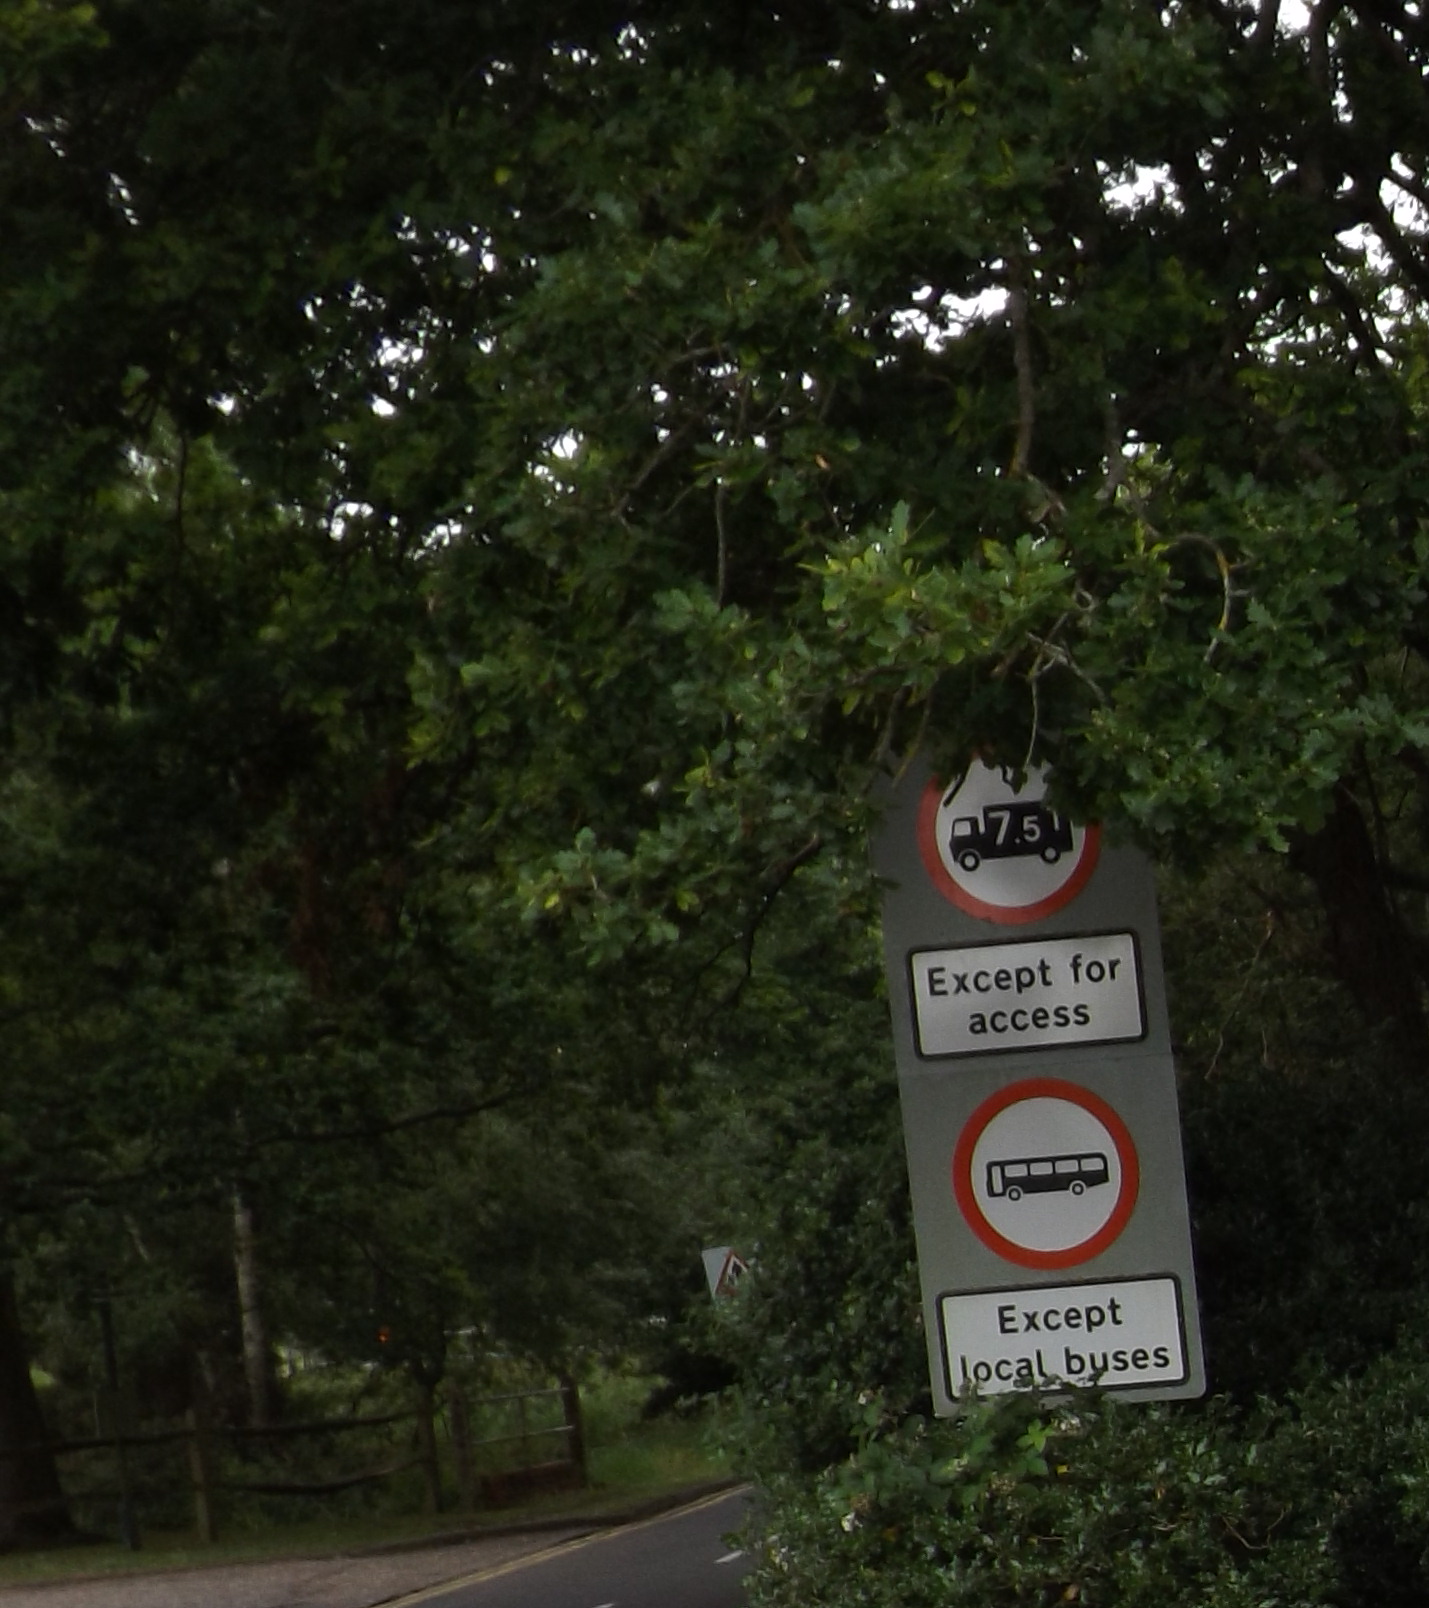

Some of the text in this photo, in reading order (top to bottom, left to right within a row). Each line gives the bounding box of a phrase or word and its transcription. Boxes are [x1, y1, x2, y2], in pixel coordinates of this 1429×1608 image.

[927, 953, 1121, 996] Except for
[969, 1003, 1091, 1035] access
[998, 1297, 1123, 1334] Except
[960, 1346, 1171, 1382] local buses
